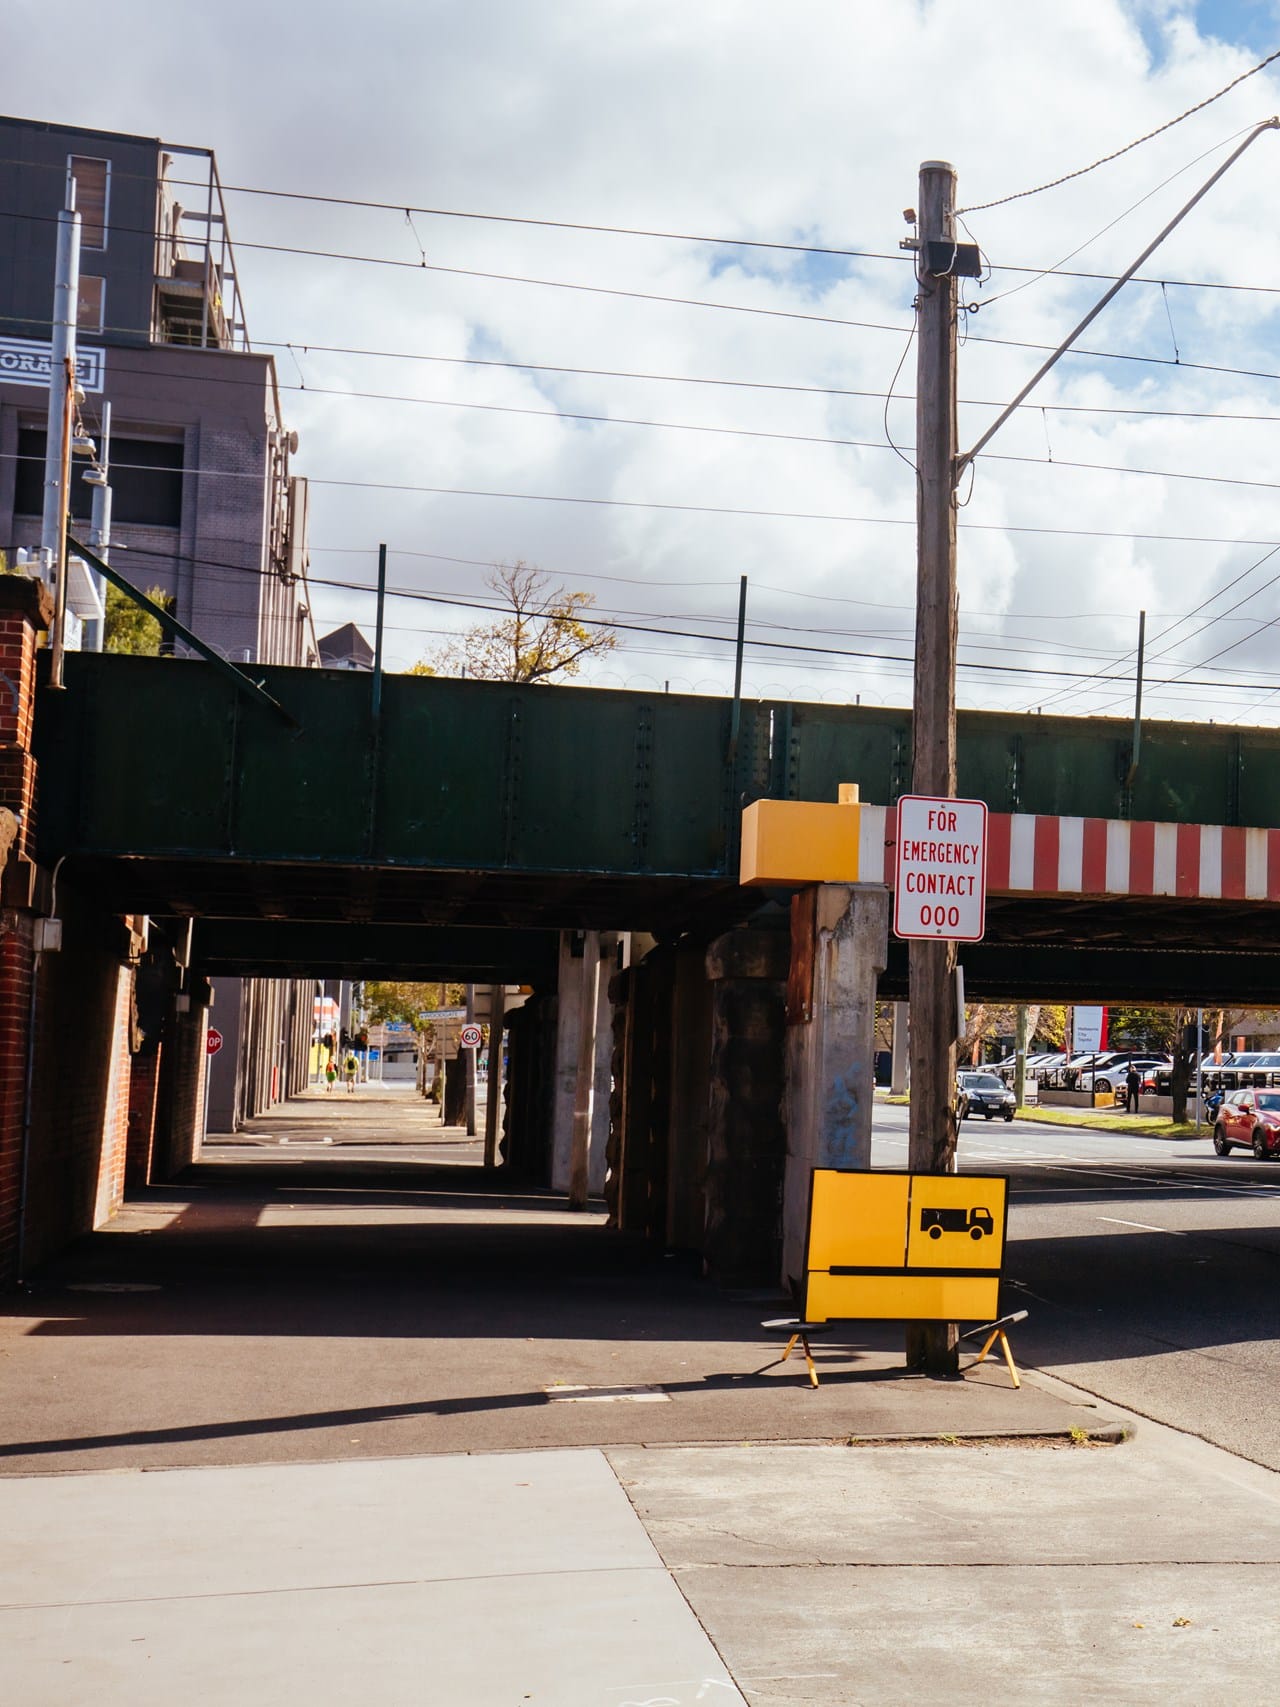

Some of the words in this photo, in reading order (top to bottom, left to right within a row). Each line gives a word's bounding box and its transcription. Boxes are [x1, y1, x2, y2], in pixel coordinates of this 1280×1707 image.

[928, 810, 957, 832] FOR
[903, 840, 979, 865] EMERGENCY
[906, 872, 976, 896] CONTACT
[465, 1031, 477, 1040] 60
